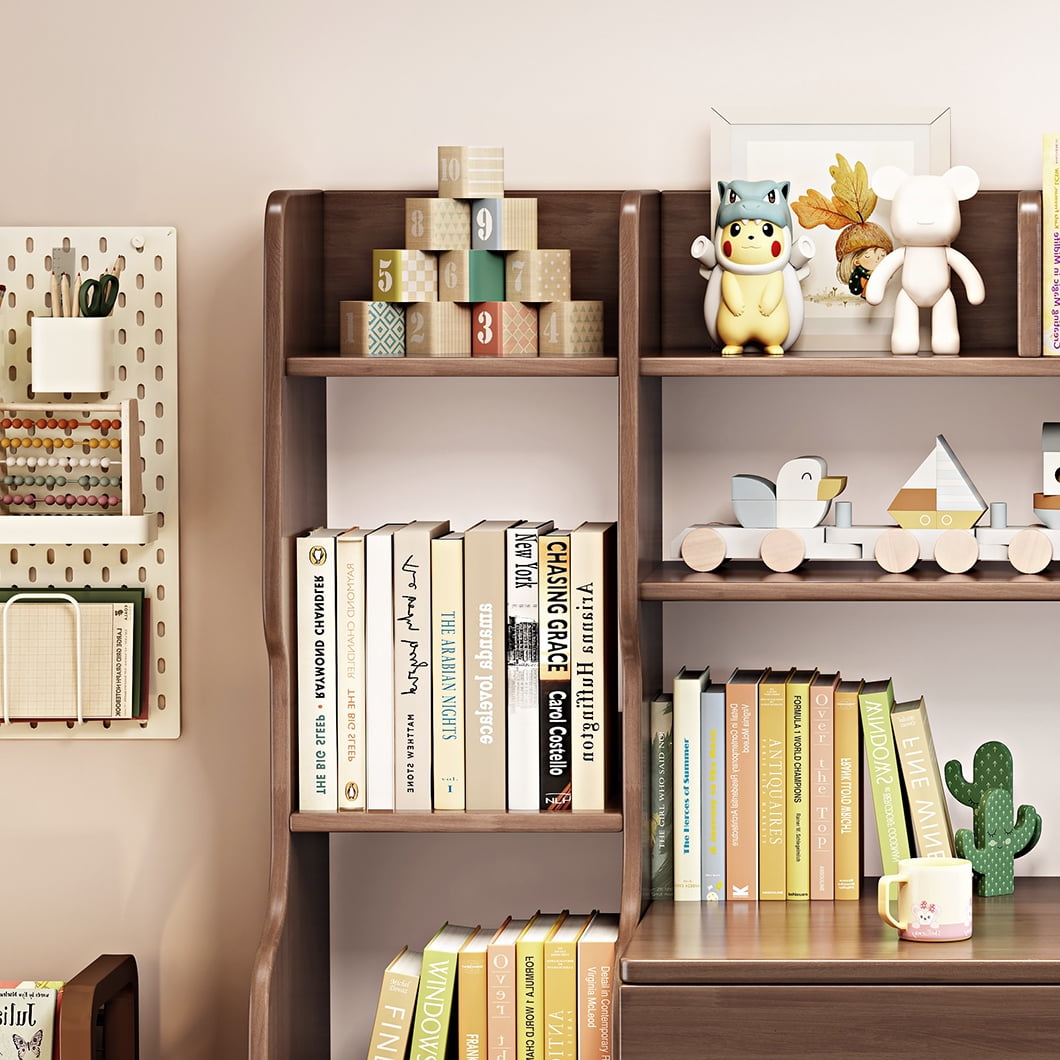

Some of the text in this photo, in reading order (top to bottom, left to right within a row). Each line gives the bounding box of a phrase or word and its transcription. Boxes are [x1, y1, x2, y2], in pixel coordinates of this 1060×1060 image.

[441, 158, 460, 182] 10
[411, 209, 424, 237] 8
[476, 207, 493, 241] 9
[377, 259, 393, 292] 5
[444, 262, 458, 288] 6
[511, 261, 525, 291] 7
[345, 312, 355, 343] 1
[410, 312, 425, 343] 2
[477, 311, 493, 345] 3
[543, 312, 558, 343] 4
[515, 533, 537, 558] New
[515, 562, 538, 589] York
[546, 541, 567, 672] CHASING GRACE
[440, 611, 457, 741] THE ARABIAN NIGHTS
[549, 690, 567, 723] Carol
[794, 695, 802, 728] FORMULA
[549, 727, 567, 776] Costello
[794, 736, 802, 760] WORLD
[794, 762, 802, 803] CHAMPIONS
[815, 693, 828, 849] Over the Top
[683, 785, 690, 795] of
[767, 738, 782, 845] ANTIQUAIRES
[600, 966, 611, 989] Detail
[585, 967, 596, 1028] Virginia McLeod
[597, 998, 610, 1052] Contemporary
